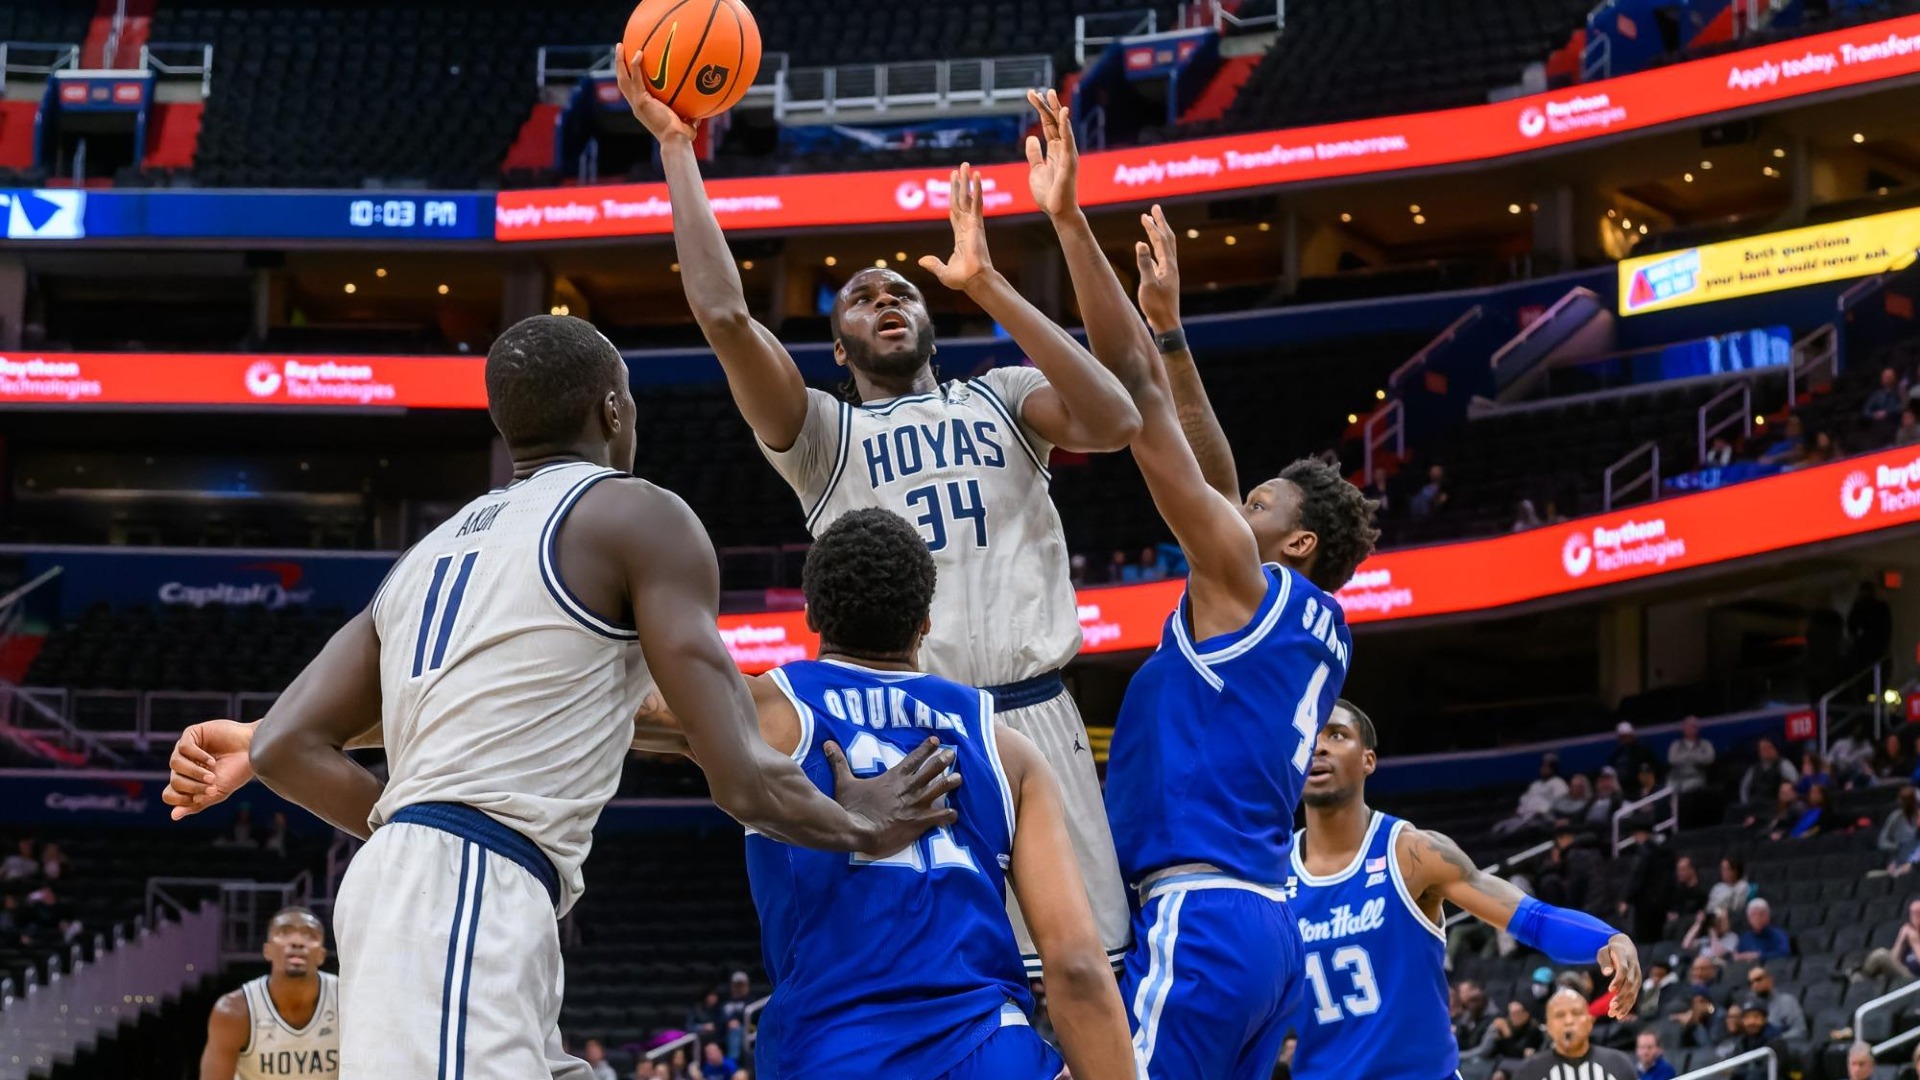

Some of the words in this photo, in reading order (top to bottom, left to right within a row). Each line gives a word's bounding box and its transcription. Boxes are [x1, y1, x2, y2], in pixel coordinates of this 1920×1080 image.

[1728, 61, 1779, 90] Apply
[1781, 53, 1838, 77] today.
[1113, 161, 1164, 186] Apply
[1166, 156, 1222, 177] today.
[1224, 145, 1314, 170] Transform
[349, 200, 416, 227] 10:03
[423, 200, 457, 227] PM
[601, 196, 673, 218] Transfo
[285, 360, 372, 383] Raytheon
[286, 379, 396, 403] Technologies
[861, 418, 1006, 490] HOYAS
[905, 479, 989, 552] 34
[1593, 519, 1666, 551] Raytheon
[1594, 537, 1686, 572] Technologies
[410, 550, 482, 679] 11
[1291, 660, 1331, 775] 4
[1329, 897, 1386, 939] Hall
[1305, 945, 1382, 1025] 13
[260, 1049, 339, 1075] HOYAS
